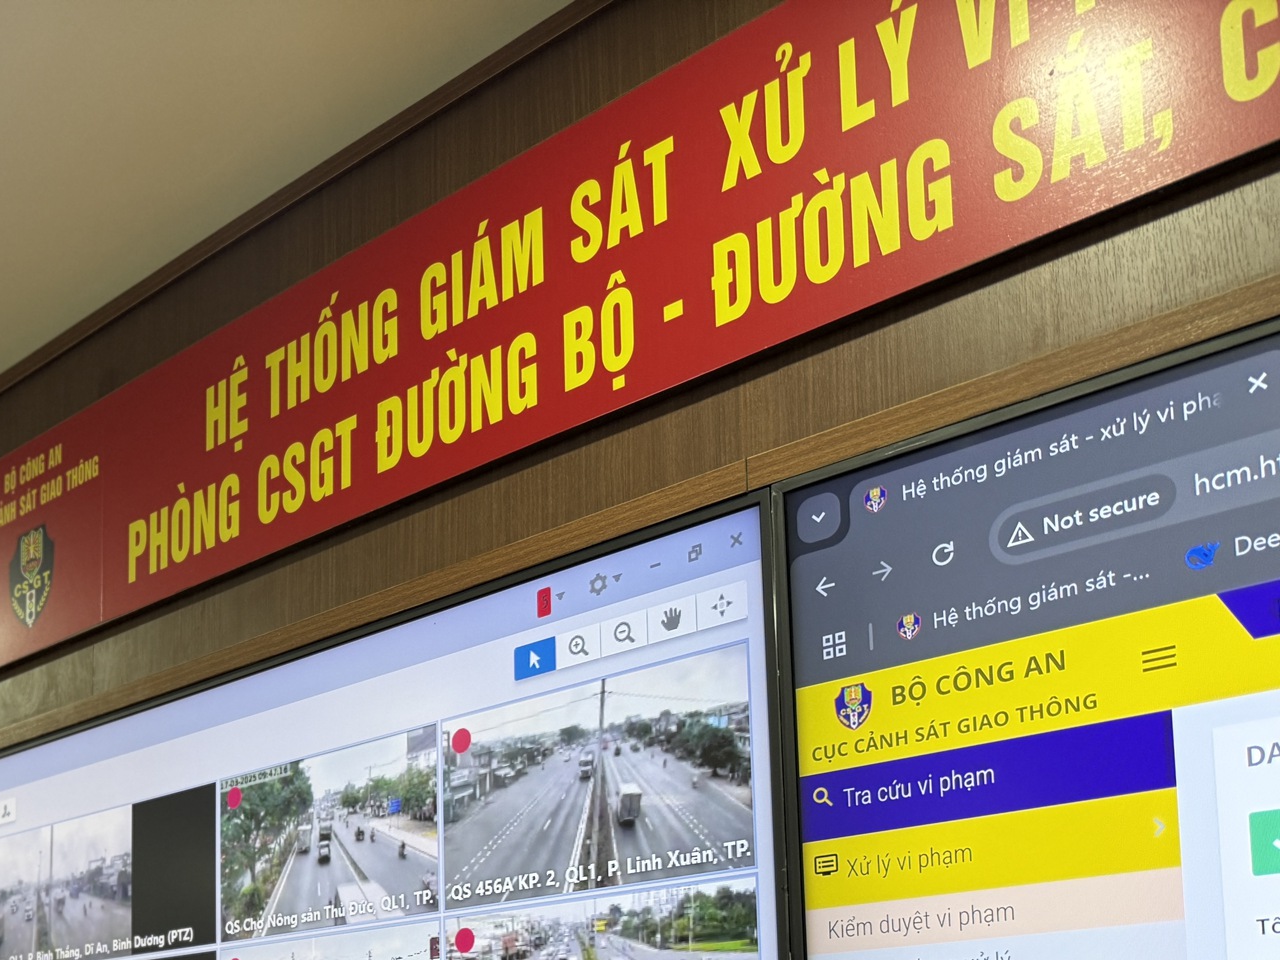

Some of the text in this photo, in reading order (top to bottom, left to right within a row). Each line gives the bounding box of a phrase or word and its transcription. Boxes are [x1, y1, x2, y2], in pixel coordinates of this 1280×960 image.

[206, 355, 248, 452] HỆ
[265, 291, 398, 419] THỐNG
[420, 219, 544, 340] GIÁM
[569, 136, 674, 264] SÁT
[719, 42, 812, 192] XỬ
[838, 0, 918, 132] LÝ
[128, 483, 240, 584] PHÒNG
[257, 416, 357, 524] CSGT
[376, 332, 537, 474] ĐƯỜNG
[563, 270, 634, 391] BỘ
[711, 168, 954, 327] ĐƯỜNG
[993, 28, 1173, 202] SÁT,
[4, 444, 62, 494] BỘ CÔNG AN
[20, 488, 37, 516] SÁT
[40, 476, 62, 505] GIAO
[66, 455, 99, 491] THÔNG
[1042, 490, 1160, 535] Not secure
[891, 650, 1067, 707] BỘ CÔNG AN
[812, 693, 1098, 764] CỤC CẢNH SÁT GIAO THÔNG
[844, 766, 995, 808] Tra cứu vi phạm
[451, 840, 751, 900] QS 456A KP. 2, QL1, P. Linh Xuân, TP.
[113, 939, 131, 951] Bình
[134, 935, 164, 947] Dương
[168, 929, 193, 944] (PTZ)
[225, 890, 433, 934] QS Chợ Nông sản Thủ Đức, QL1, TP.
